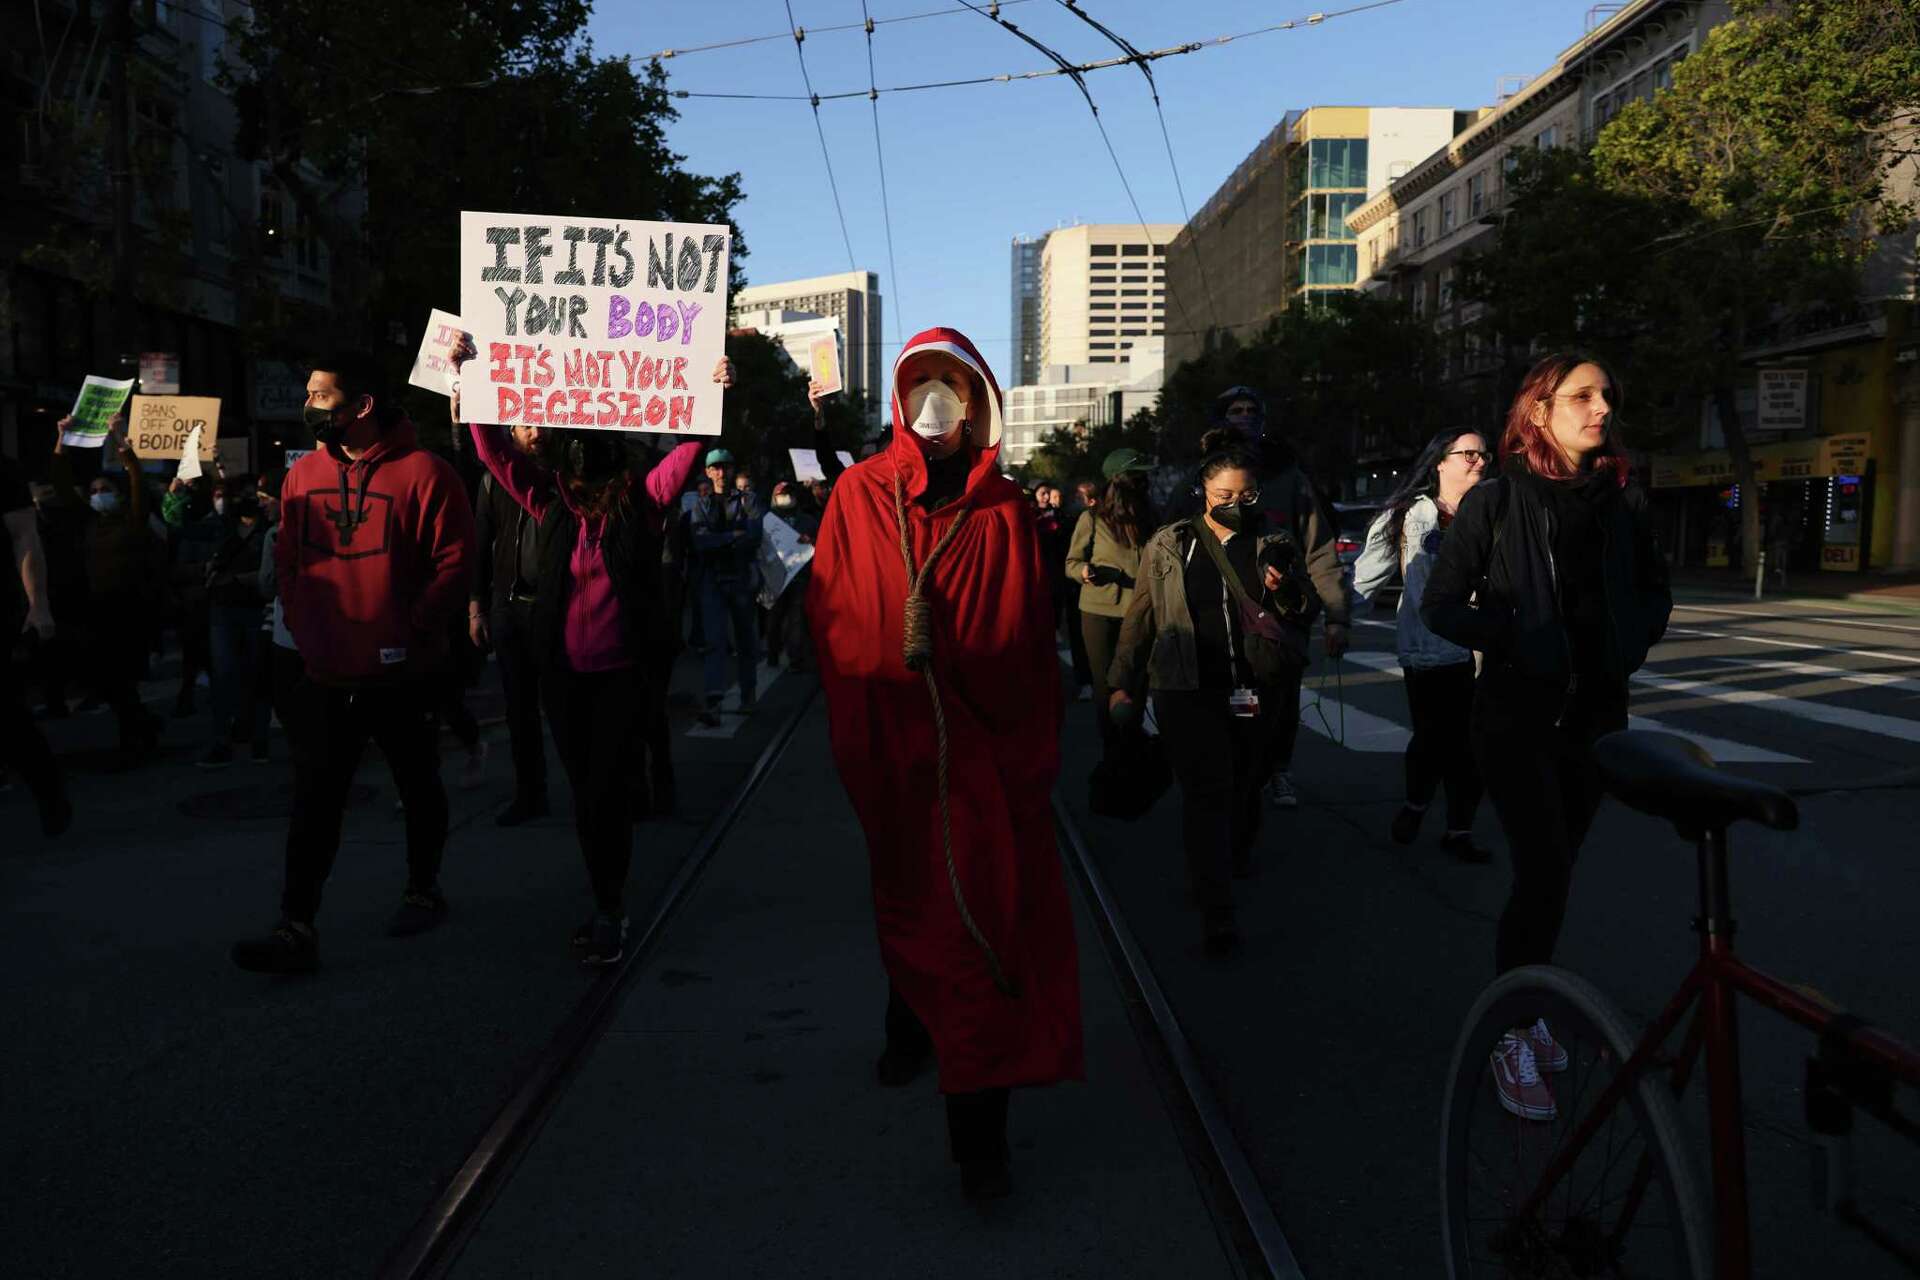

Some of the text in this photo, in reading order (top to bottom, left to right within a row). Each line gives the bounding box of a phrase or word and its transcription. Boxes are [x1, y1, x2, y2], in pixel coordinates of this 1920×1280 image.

[481, 224, 725, 293] IF IT'S NOT
[494, 286, 589, 338] YOUR
[608, 294, 703, 345] BODY
[490, 342, 555, 387] IT'S
[563, 348, 615, 389] NOT
[619, 350, 689, 391] YOUR
[140, 418, 207, 433] OFF OUR
[141, 403, 176, 418] BANS
[497, 386, 695, 430] DECISION
[1823, 547, 1855, 563] DELI
